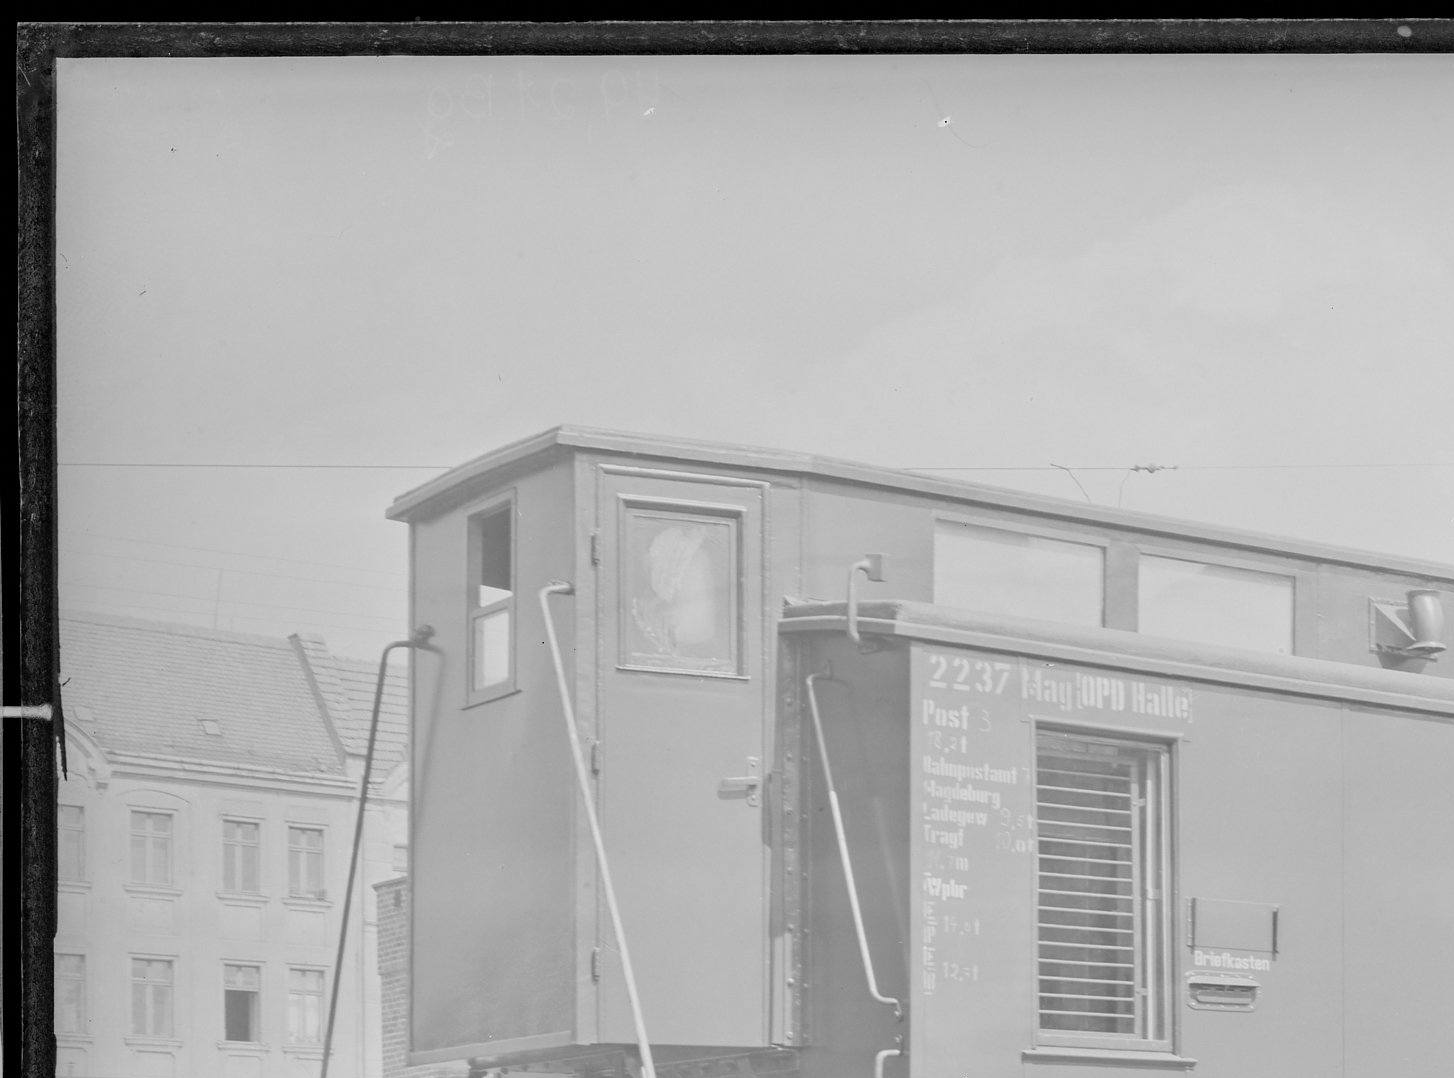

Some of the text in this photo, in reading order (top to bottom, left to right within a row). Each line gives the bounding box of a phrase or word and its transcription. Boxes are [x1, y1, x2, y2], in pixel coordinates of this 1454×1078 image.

[929, 654, 1011, 695] 2237
[922, 698, 970, 731] Post
[922, 755, 1018, 785] Bahnpostamt
[922, 779, 1001, 810] Magdeburg
[1193, 950, 1270, 972] Briefkasten
